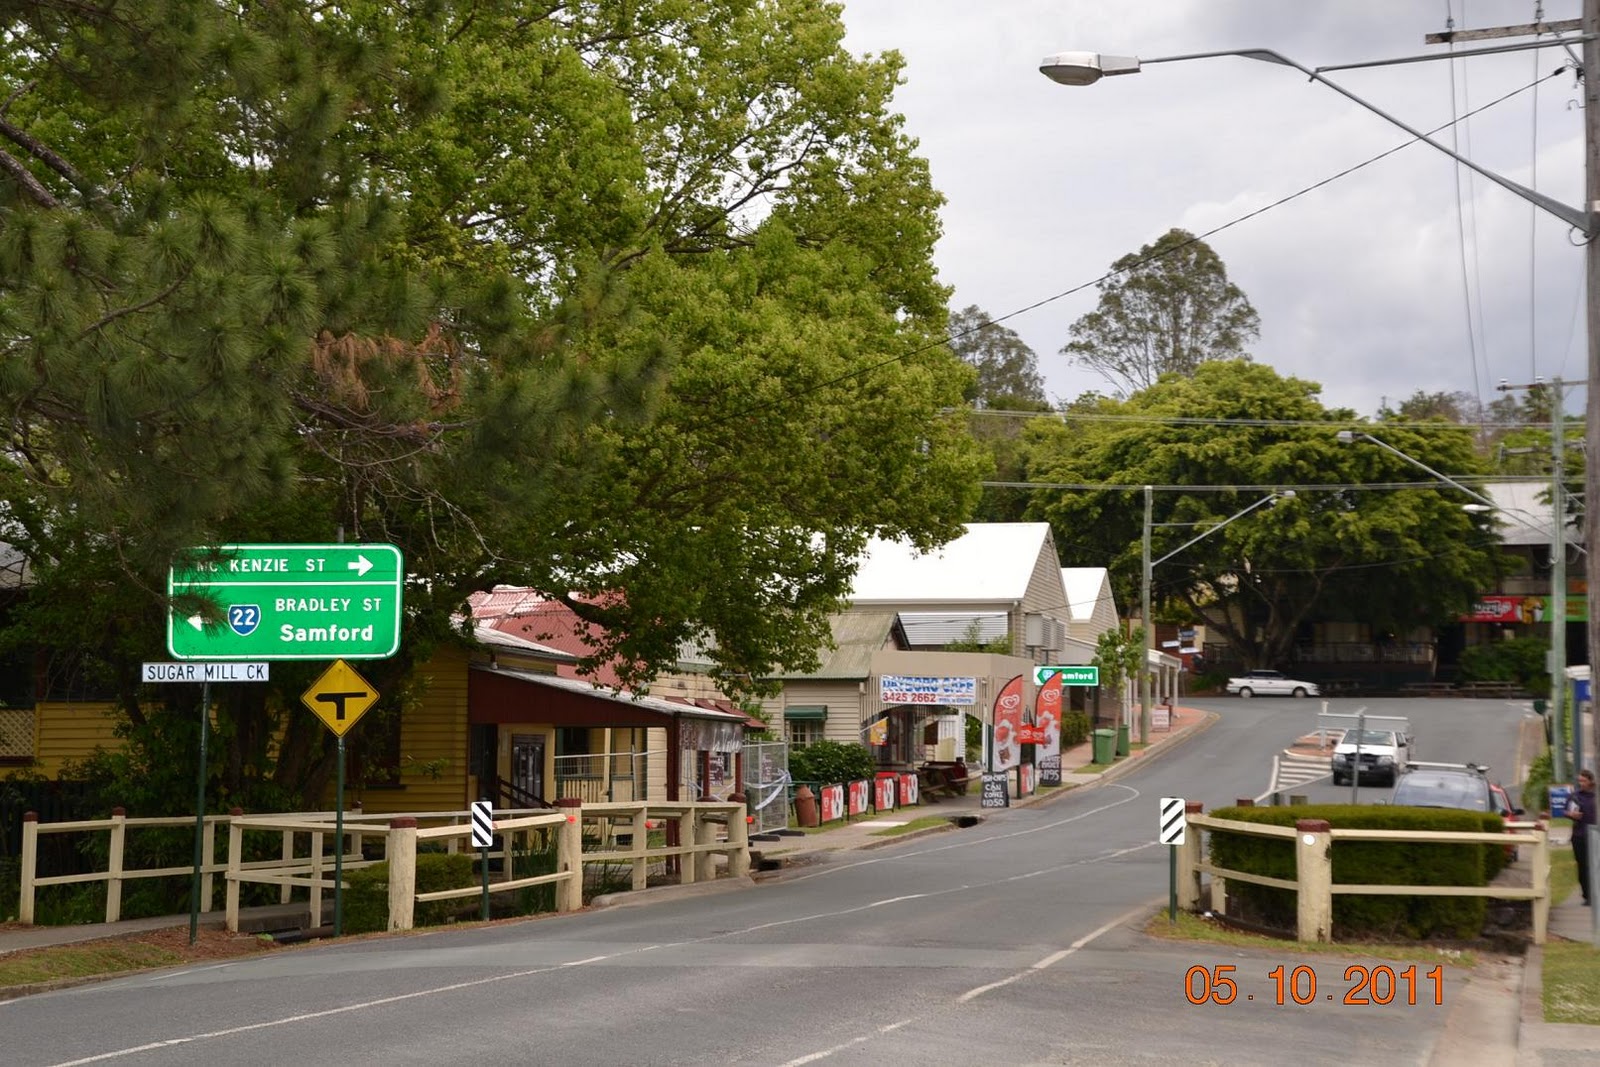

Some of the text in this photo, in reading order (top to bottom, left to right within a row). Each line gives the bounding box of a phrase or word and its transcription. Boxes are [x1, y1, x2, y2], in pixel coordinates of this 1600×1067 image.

[230, 558, 289, 572] KENZIE
[305, 558, 326, 572] ST
[275, 598, 382, 612] BRADLEY ST
[232, 608, 256, 626] 22
[280, 623, 373, 642] Samford
[147, 664, 265, 680] SUGAR MILL CK
[1061, 672, 1094, 680] amford
[882, 692, 937, 703] 3425 2662
